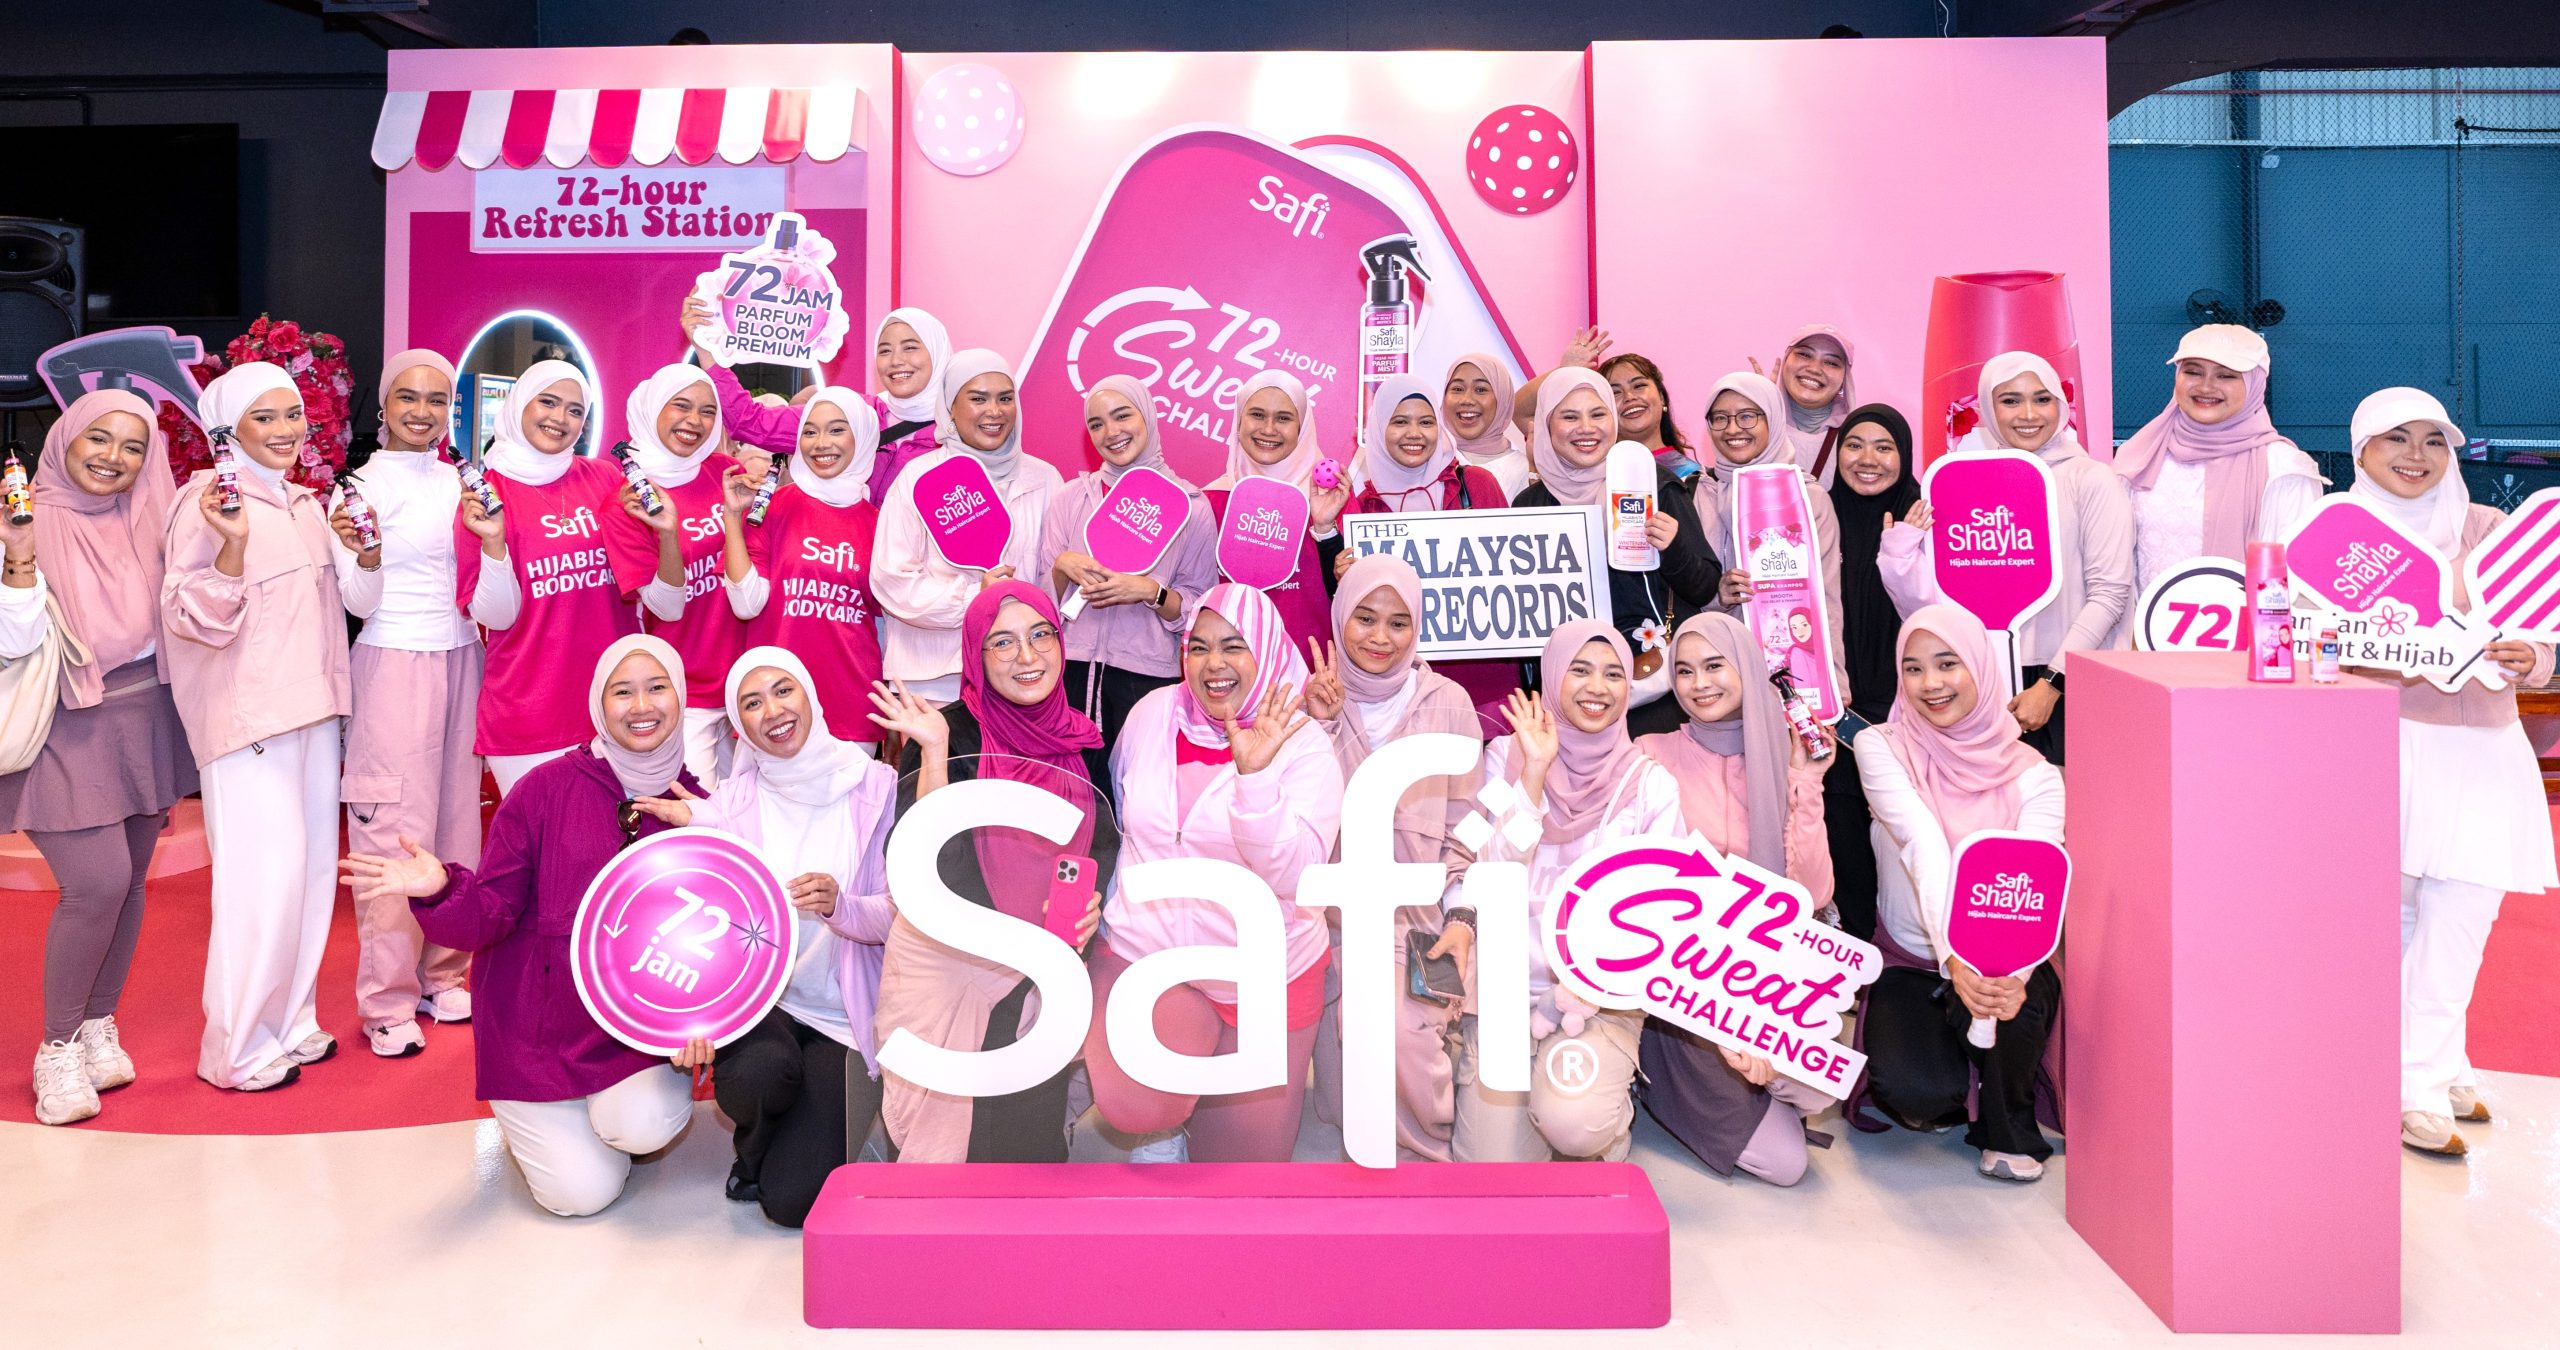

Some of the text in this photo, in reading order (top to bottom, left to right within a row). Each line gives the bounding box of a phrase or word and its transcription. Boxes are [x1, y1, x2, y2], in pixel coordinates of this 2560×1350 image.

[557, 174, 707, 206] 72-hour
[482, 205, 774, 238] Refresh Station
[1249, 175, 1331, 238] Safi
[724, 260, 833, 311] 72 JAM
[735, 304, 812, 328] PARFUM
[737, 321, 805, 343] BLOOM
[1370, 335, 1404, 348] Shayla
[725, 336, 811, 360] PREMIUM
[1114, 319, 1322, 411] Swe
[1152, 395, 1232, 446] CHAL
[935, 491, 986, 526] Shayla
[943, 484, 967, 505] Safi
[1136, 497, 1161, 517] Safi
[1623, 501, 1641, 513] Safi
[540, 506, 598, 538] Safi
[682, 503, 725, 541] Saf
[944, 506, 991, 535] Hijab Haircare Expert
[1116, 497, 1163, 537] Shayla
[1237, 513, 1289, 542] Shayla
[1256, 507, 1280, 525] Safi
[1357, 523, 1409, 538] THE
[1970, 505, 2010, 530] Safi
[801, 536, 856, 573] Safi
[1234, 534, 1285, 550] Hijab Haircare Expert
[1947, 523, 2034, 557] Shayla
[526, 547, 607, 579] HIJABIS
[1761, 558, 1797, 572] Shayla
[1950, 558, 2035, 567] Hijab Haircare Expert
[2333, 542, 2401, 599] Shayla
[2336, 541, 2367, 572] Safi
[531, 568, 616, 599] BODYCA
[1277, 581, 1300, 591] pert
[2357, 557, 2413, 610] Hijab Haircare Expert
[1420, 581, 1588, 643] RECORDS
[2166, 602, 2232, 649] 72
[1769, 635, 1781, 644] 72
[2361, 641, 2380, 660] &
[2384, 642, 2455, 668] Hijab
[1994, 872, 2030, 892] Safi
[1970, 884, 2045, 913] Shayla
[655, 885, 731, 961] 72
[1967, 910, 2042, 922] Hijab Haircare Expert
[629, 935, 701, 994] jam
[875, 731, 1543, 1168] Safi
[1596, 888, 1847, 1029] Sweat
[1646, 976, 1851, 1084] CHALLENGE
